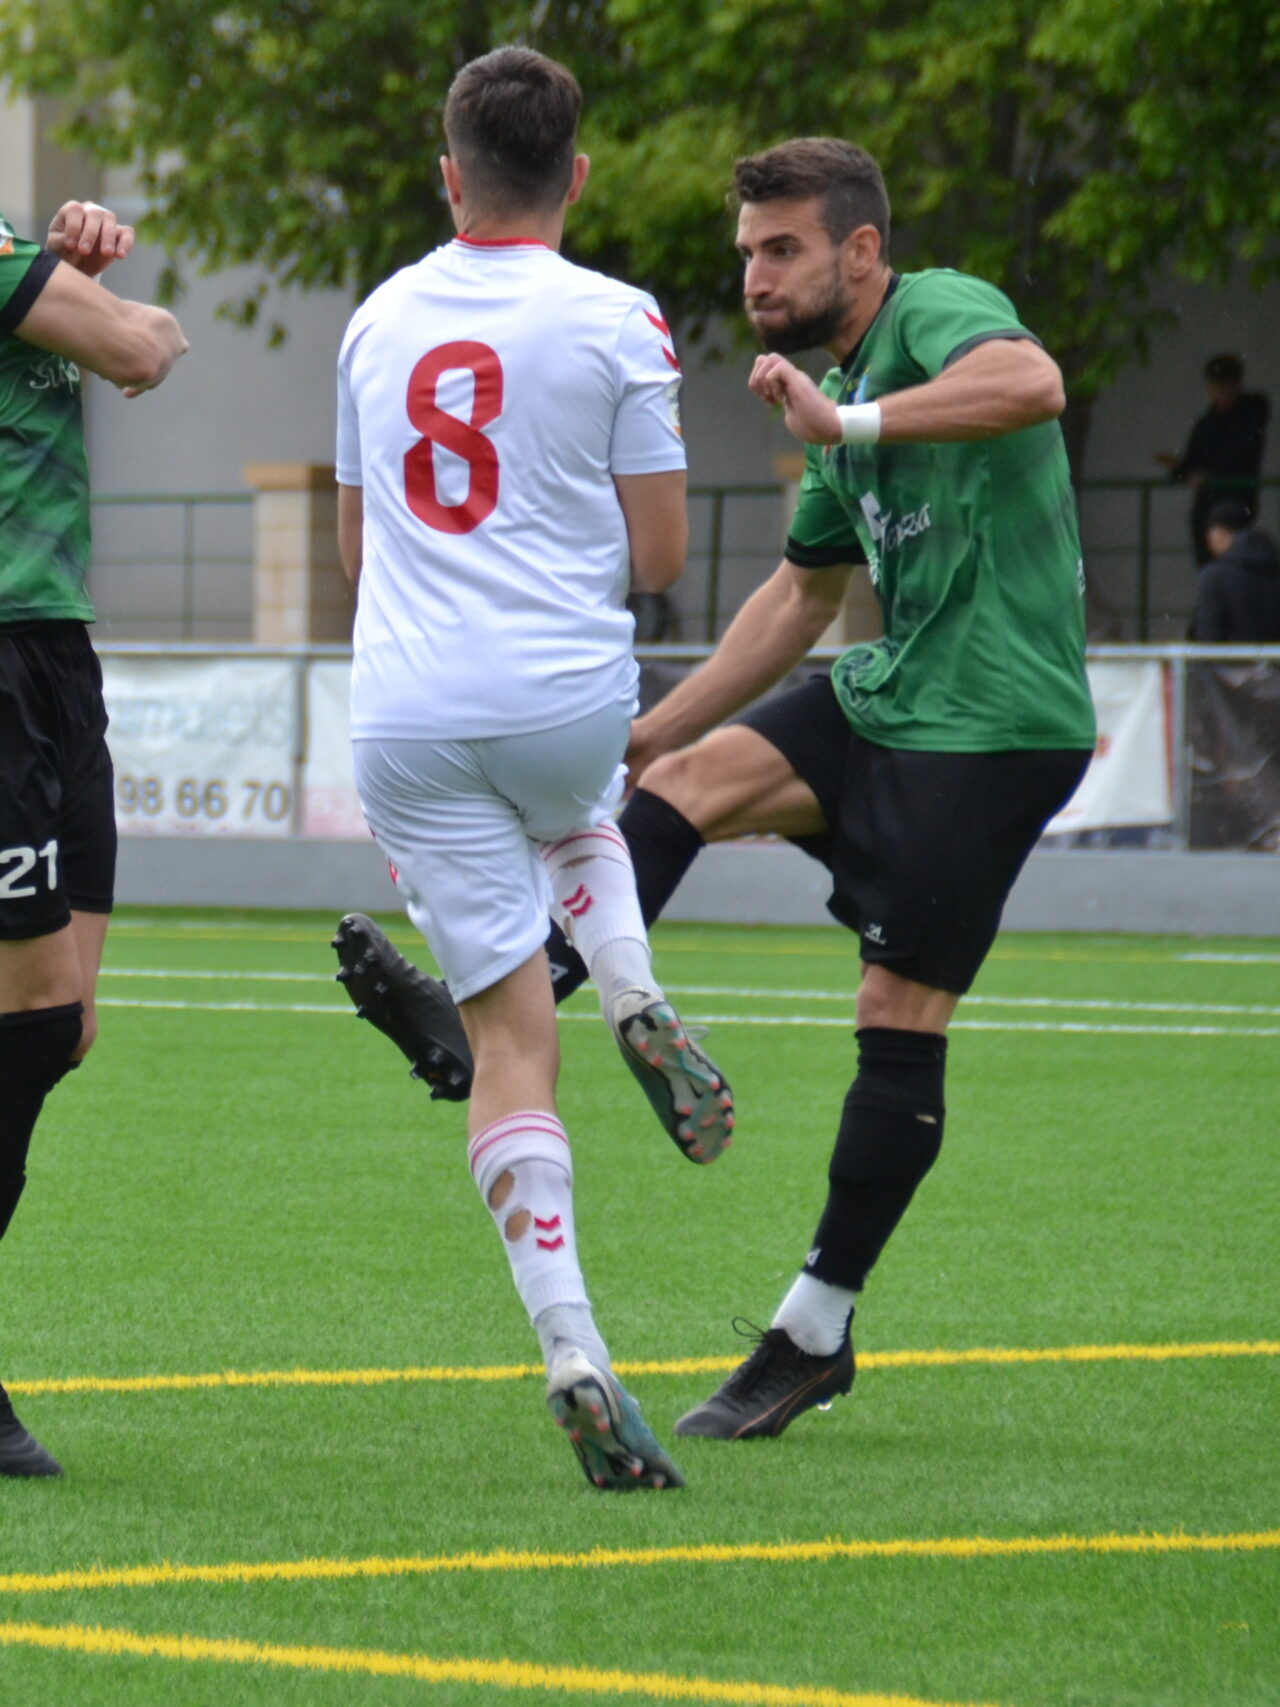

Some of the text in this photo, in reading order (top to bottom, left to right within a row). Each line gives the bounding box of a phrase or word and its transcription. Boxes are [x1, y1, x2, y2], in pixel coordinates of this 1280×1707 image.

[404, 340, 504, 535] 8
[117, 772, 165, 817] 98
[175, 775, 229, 820] 66
[241, 779, 291, 823] 70
